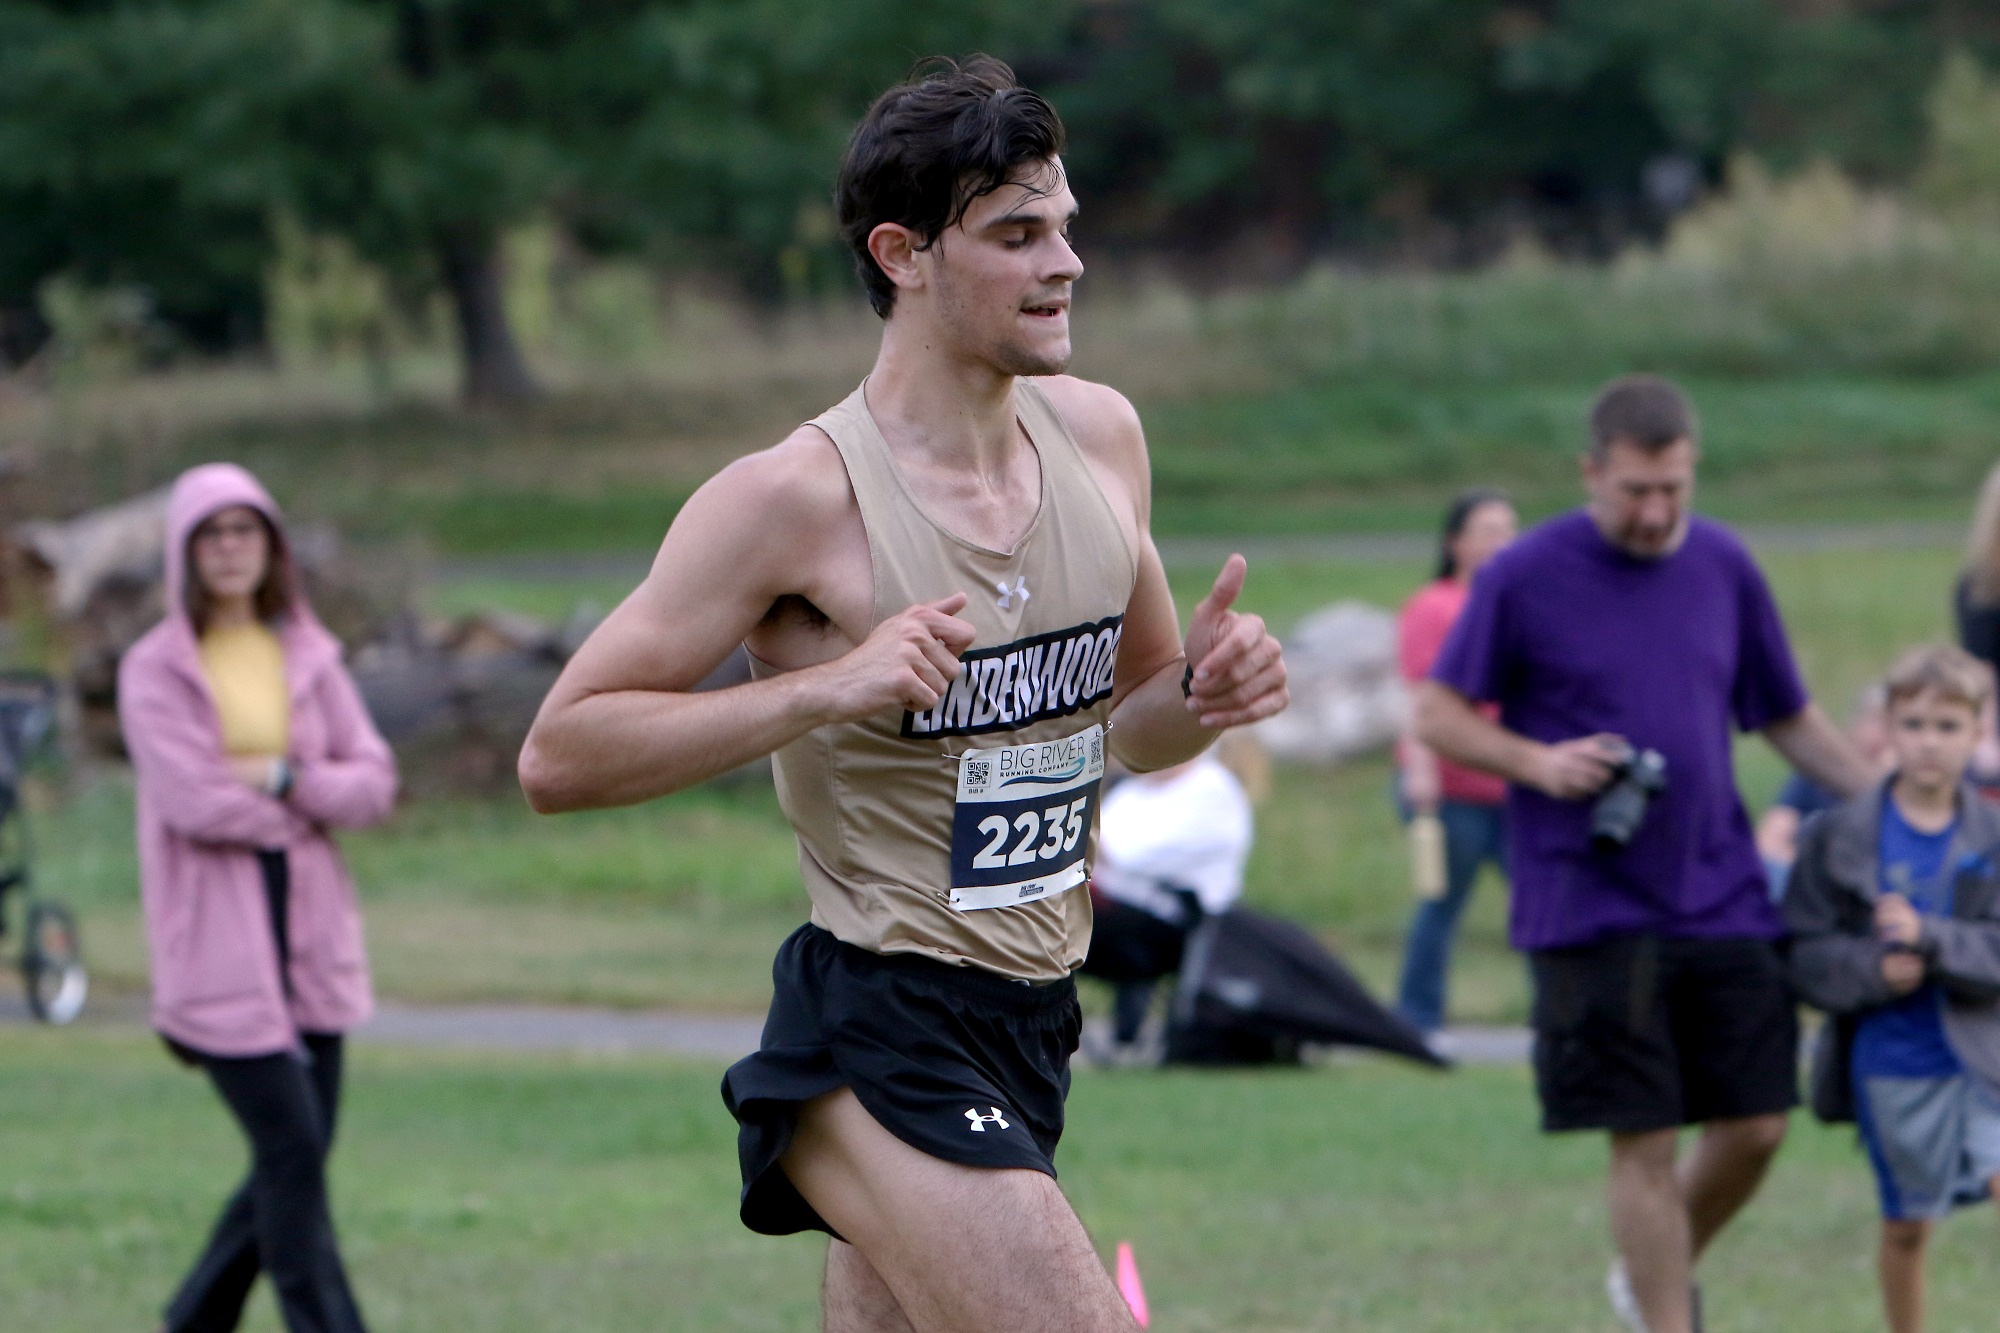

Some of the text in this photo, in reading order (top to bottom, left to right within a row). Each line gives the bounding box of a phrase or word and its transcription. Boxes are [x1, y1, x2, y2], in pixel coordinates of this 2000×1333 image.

[1000, 736, 1085, 771] BIG RIVER
[1000, 761, 1069, 777] RUNNING COMPANY
[972, 795, 1087, 869] 2235
